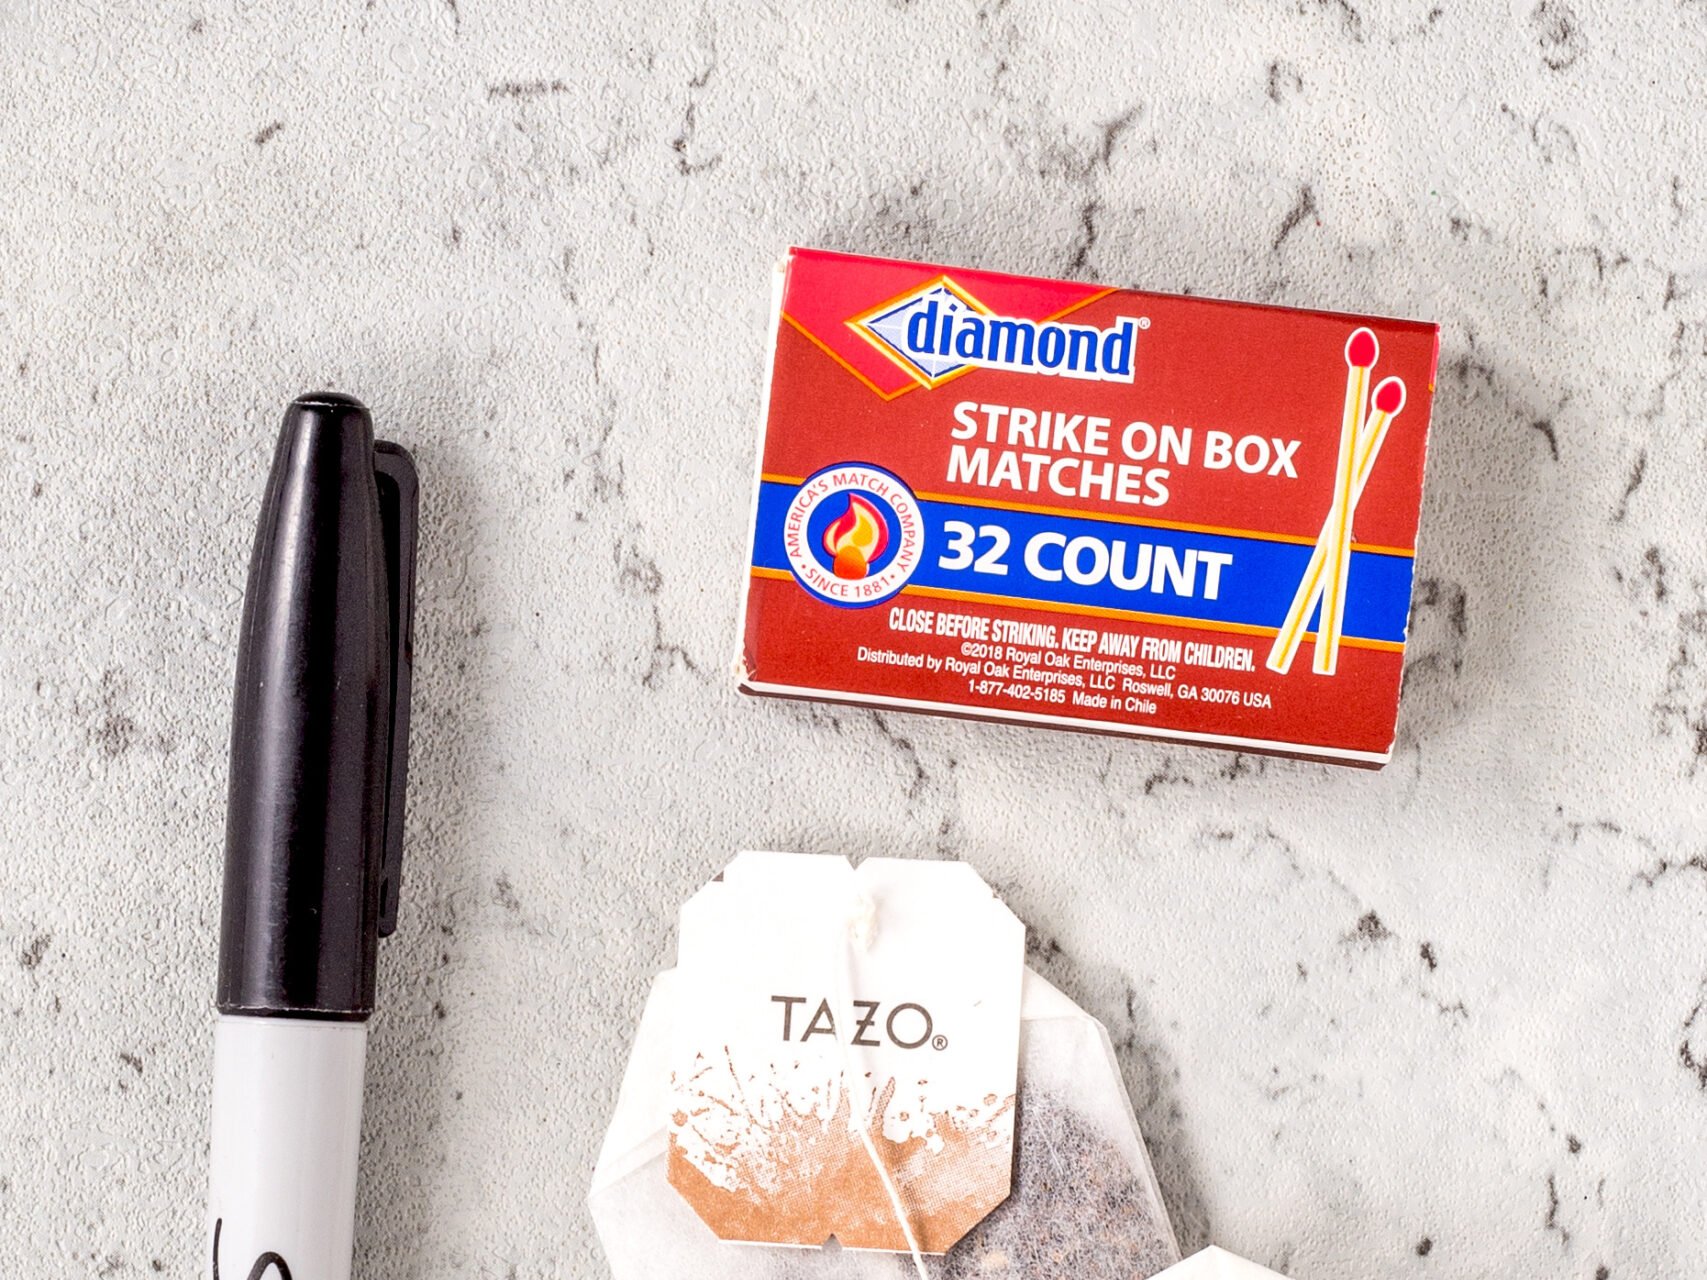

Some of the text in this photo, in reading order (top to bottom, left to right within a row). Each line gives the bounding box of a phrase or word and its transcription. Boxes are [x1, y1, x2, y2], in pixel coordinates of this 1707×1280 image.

[950, 401, 1302, 479] STRIKE ON BOX
[946, 445, 1171, 508] MATCHES
[787, 472, 916, 573] AMERICA'S MATCH COMPANY
[805, 568, 891, 598] SINCE 1881
[937, 520, 1234, 600] 32 COUNT
[889, 607, 1256, 672] CLOSE BEFORE STRIKING. KEEP AWAY FROM CHILDREN.
[1006, 647, 1042, 667] Royal
[1044, 652, 1071, 668] Oak
[1073, 655, 1146, 679] Enterprises,
[1149, 664, 1176, 680] LLC
[857, 646, 1272, 709] Distributed by Royal Oak Enterprises, LLC Roswell, GA 30076 USA
[968, 679, 1157, 714] 1-877-402-5185 Made in Chile
